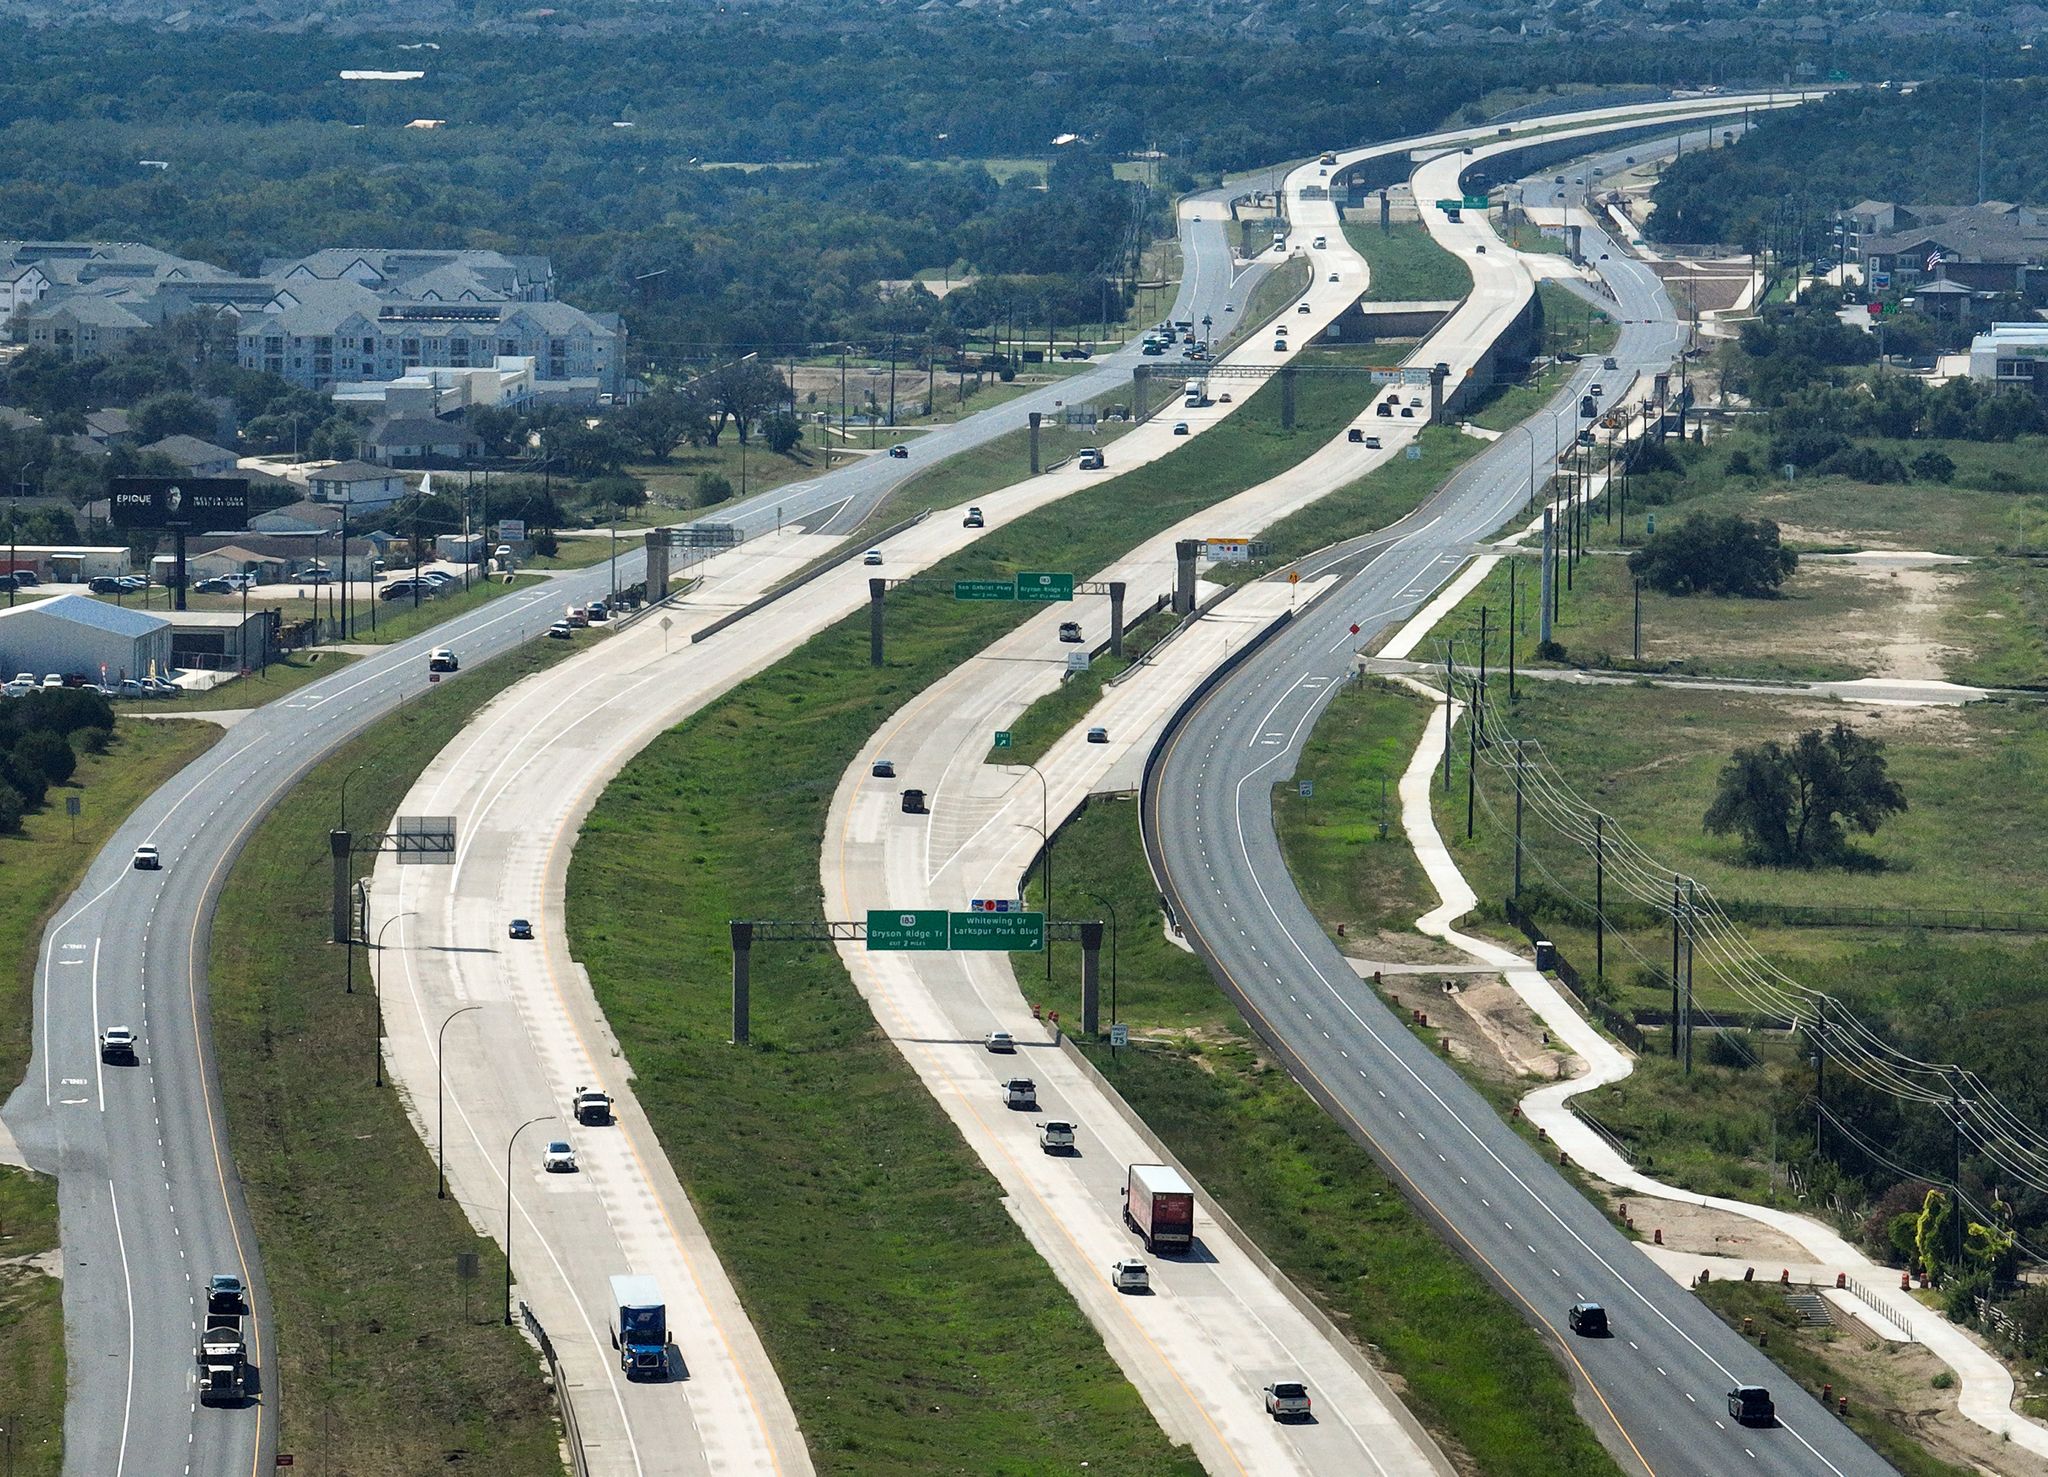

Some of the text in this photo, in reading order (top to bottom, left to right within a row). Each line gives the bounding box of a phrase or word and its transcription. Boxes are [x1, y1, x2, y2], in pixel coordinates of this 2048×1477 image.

[116, 494, 152, 503] EPIQUE
[901, 916, 914, 924] 183
[967, 917, 1027, 926] Whitewing Dr
[872, 930, 902, 939] Bryson
[905, 929, 931, 939] Ridge
[954, 928, 993, 937] Larkspur
